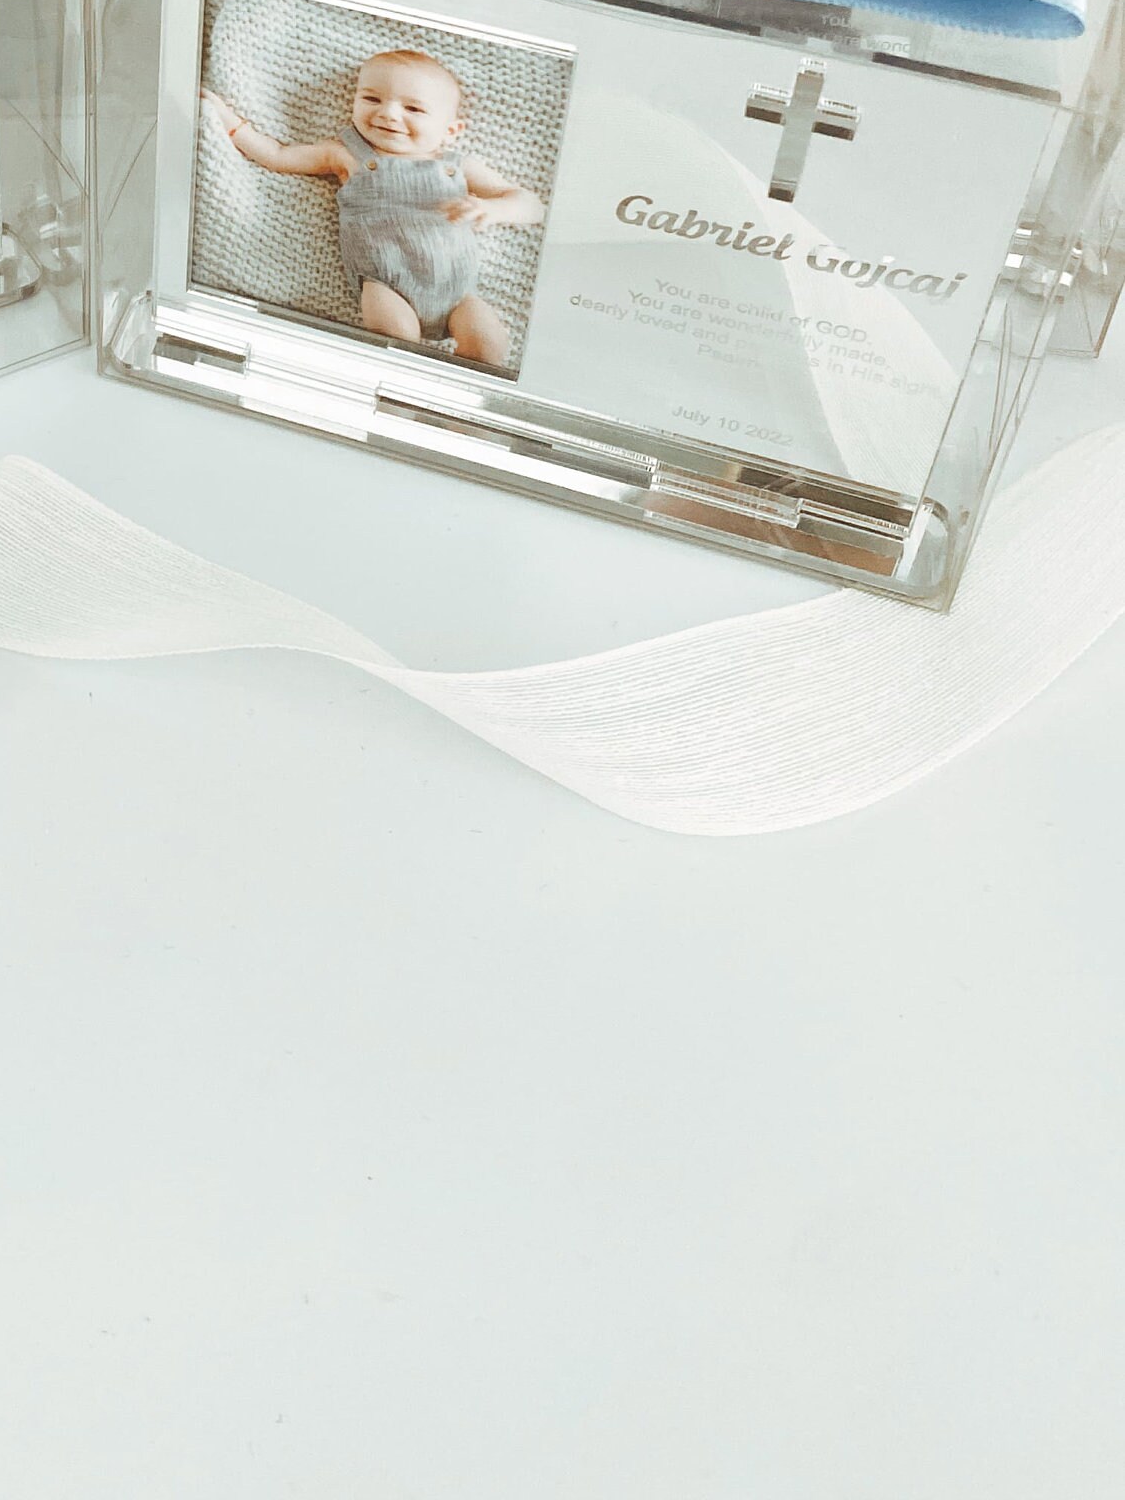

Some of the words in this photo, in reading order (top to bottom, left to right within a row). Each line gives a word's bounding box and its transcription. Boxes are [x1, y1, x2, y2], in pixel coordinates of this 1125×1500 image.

[616, 195, 795, 261] Gabriel
[806, 244, 969, 305] Gojcaj
[570, 294, 630, 321] dearly
[634, 310, 688, 334] loved
[628, 289, 665, 311] You
[670, 303, 703, 321] are
[829, 343, 892, 370] made,
[655, 278, 691, 300] You
[697, 292, 730, 310] are
[736, 302, 784, 323] child
[789, 316, 812, 329] of
[816, 320, 873, 346] GOD.
[671, 406, 711, 426] July
[719, 416, 741, 432] 10
[745, 423, 795, 447] 2022
